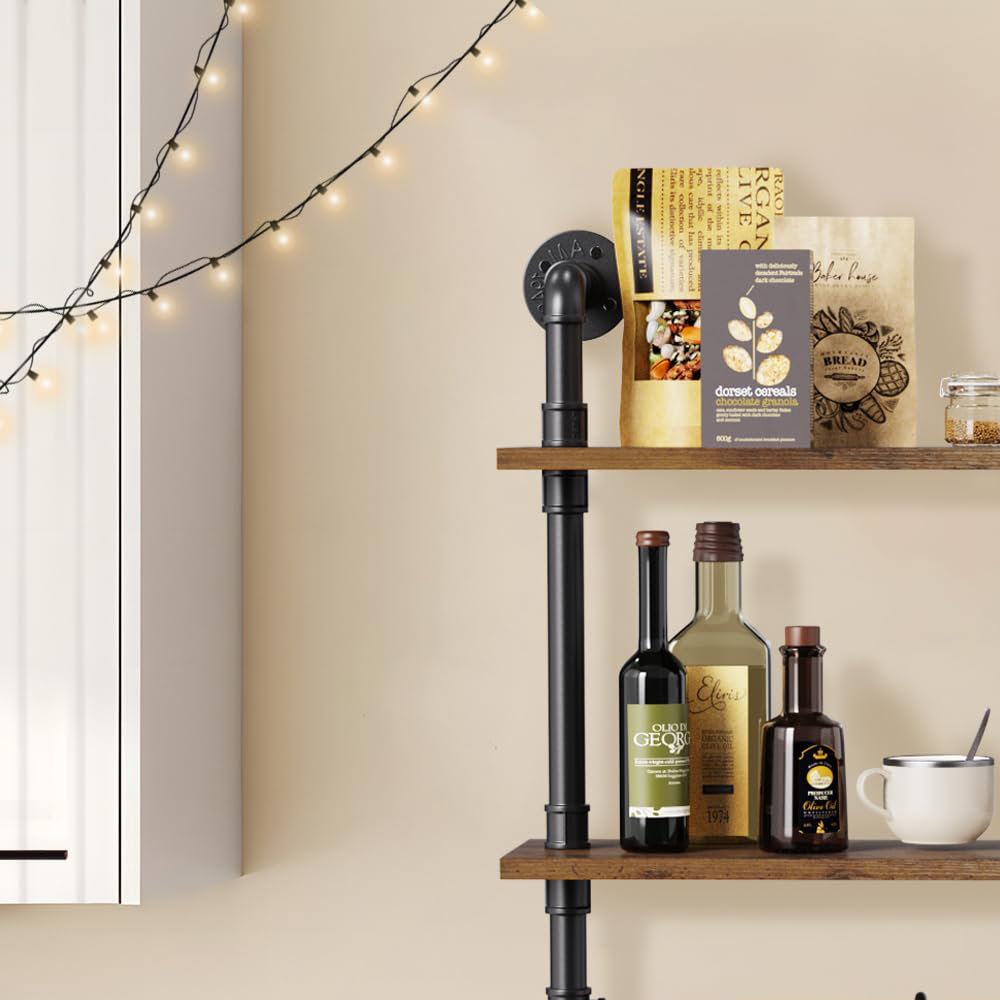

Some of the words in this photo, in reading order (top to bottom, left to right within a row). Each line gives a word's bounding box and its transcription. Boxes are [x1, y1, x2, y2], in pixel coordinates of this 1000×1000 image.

[679, 194, 687, 233] collection
[707, 204, 714, 212] of
[716, 204, 724, 231] within
[716, 235, 724, 245] its
[637, 216, 648, 279] ESTATE
[687, 249, 696, 292] produced
[813, 261, 842, 283] Baker
[848, 261, 879, 284] house
[823, 355, 867, 367] BREAD
[715, 385, 753, 397] dorset
[755, 385, 797, 397] cereals
[716, 397, 760, 406] chocolate
[762, 397, 799, 408] granola
[652, 723, 679, 732] OLIO
[803, 800, 824, 810] Olive
[825, 800, 837, 810] Oil
[708, 809, 729, 824] 1974
